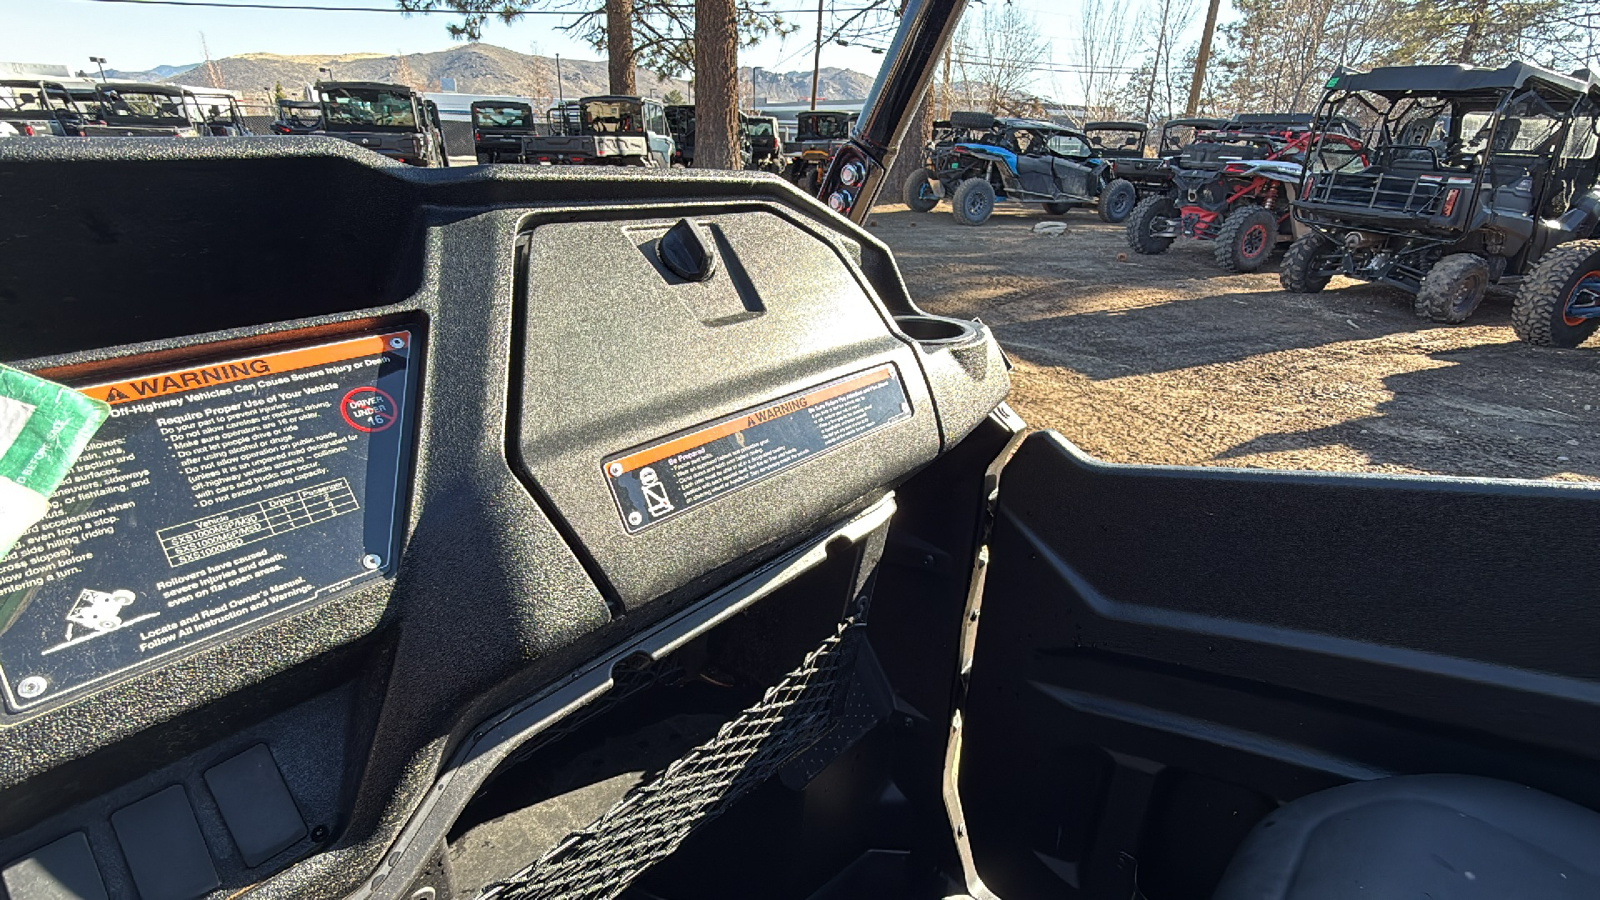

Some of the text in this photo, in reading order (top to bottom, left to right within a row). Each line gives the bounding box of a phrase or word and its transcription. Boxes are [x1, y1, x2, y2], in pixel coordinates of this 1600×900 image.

[108, 397, 184, 418] Off-Highway
[184, 388, 233, 403] Vehicles
[233, 383, 257, 393] Can
[257, 377, 291, 388] Cause
[290, 369, 325, 382] Severe
[324, 364, 352, 375] Injury
[364, 356, 391, 367] Death
[129, 359, 271, 396] WARNING
[156, 382, 339, 427] Require Proper Use of Your Vehicle
[350, 396, 384, 409] DRIVER
[353, 404, 386, 418] UNDER
[757, 398, 808, 421] WARNING
[159, 427, 175, 436] Do
[176, 423, 196, 433] your
[197, 418, 216, 428] part
[226, 409, 258, 422] prevent
[258, 403, 290, 414] injuries:
[169, 434, 184, 442] Do
[185, 429, 201, 438] not
[202, 425, 224, 434] allow
[226, 418, 261, 429] careless
[271, 407, 304, 419] reckless
[304, 401, 332, 411] driving.
[173, 439, 199, 450] Make
[201, 435, 220, 444] sure
[221, 426, 262, 439] operators
[277, 418, 289, 426] 16
[298, 412, 321, 421] older.
[367, 414, 384, 426] 16
[84, 438, 126, 451] ollovers:
[102, 447, 126, 457] ruts,
[177, 450, 192, 458] Do
[193, 446, 209, 454] not
[208, 443, 221, 451] let
[221, 436, 250, 449] people
[251, 431, 272, 441] drive
[283, 424, 299, 433] ride
[180, 456, 201, 467] after
[202, 451, 227, 461] using
[228, 442, 259, 455] alcohol
[269, 434, 295, 444] drugs.
[184, 466, 199, 475] Do
[200, 462, 215, 470] not
[216, 457, 239, 467] allow
[240, 446, 279, 461] operation
[291, 437, 316, 449] public
[315, 431, 338, 441] roads
[251, 452, 287, 466] unpaved
[287, 447, 306, 457] road
[306, 436, 348, 452] designated
[677, 446, 706, 462] Prepared
[75, 467, 121, 482] surfaces.
[76, 459, 114, 472] traction
[116, 452, 136, 464] and
[191, 446, 348, 491] off-highway vehicle access) collisions
[52, 481, 102, 497] aneuvers,
[104, 469, 151, 485] sideways
[64, 477, 151, 504] or fishtailing, and
[194, 461, 321, 499] with cars and trucks can occur.
[199, 499, 214, 508] Do
[214, 494, 231, 503] not
[231, 484, 263, 499] exceed
[263, 477, 294, 489] seating
[42, 509, 106, 530] acceleration
[106, 501, 136, 513] when
[195, 481, 345, 529] Vehicle Driver Passenger
[21, 546, 45, 557] side
[46, 536, 81, 549] hilling
[81, 526, 115, 541] (riding
[28, 532, 56, 544] even
[57, 525, 82, 536] from
[93, 516, 120, 527] stop.
[24, 563, 56, 577] down
[57, 552, 94, 567] before
[29, 547, 74, 565] slopes).
[156, 547, 268, 591] Rollovers have caused
[46, 574, 55, 582] a
[55, 567, 82, 580] turn.
[162, 553, 288, 599] severe injuries and death,
[167, 564, 286, 608] even on flat open areas.
[139, 576, 306, 641] Locate and Read Owner's Manual.
[139, 633, 176, 653] Follow
[178, 626, 194, 638] All
[249, 598, 269, 611] and
[268, 584, 316, 604] Warnings.
